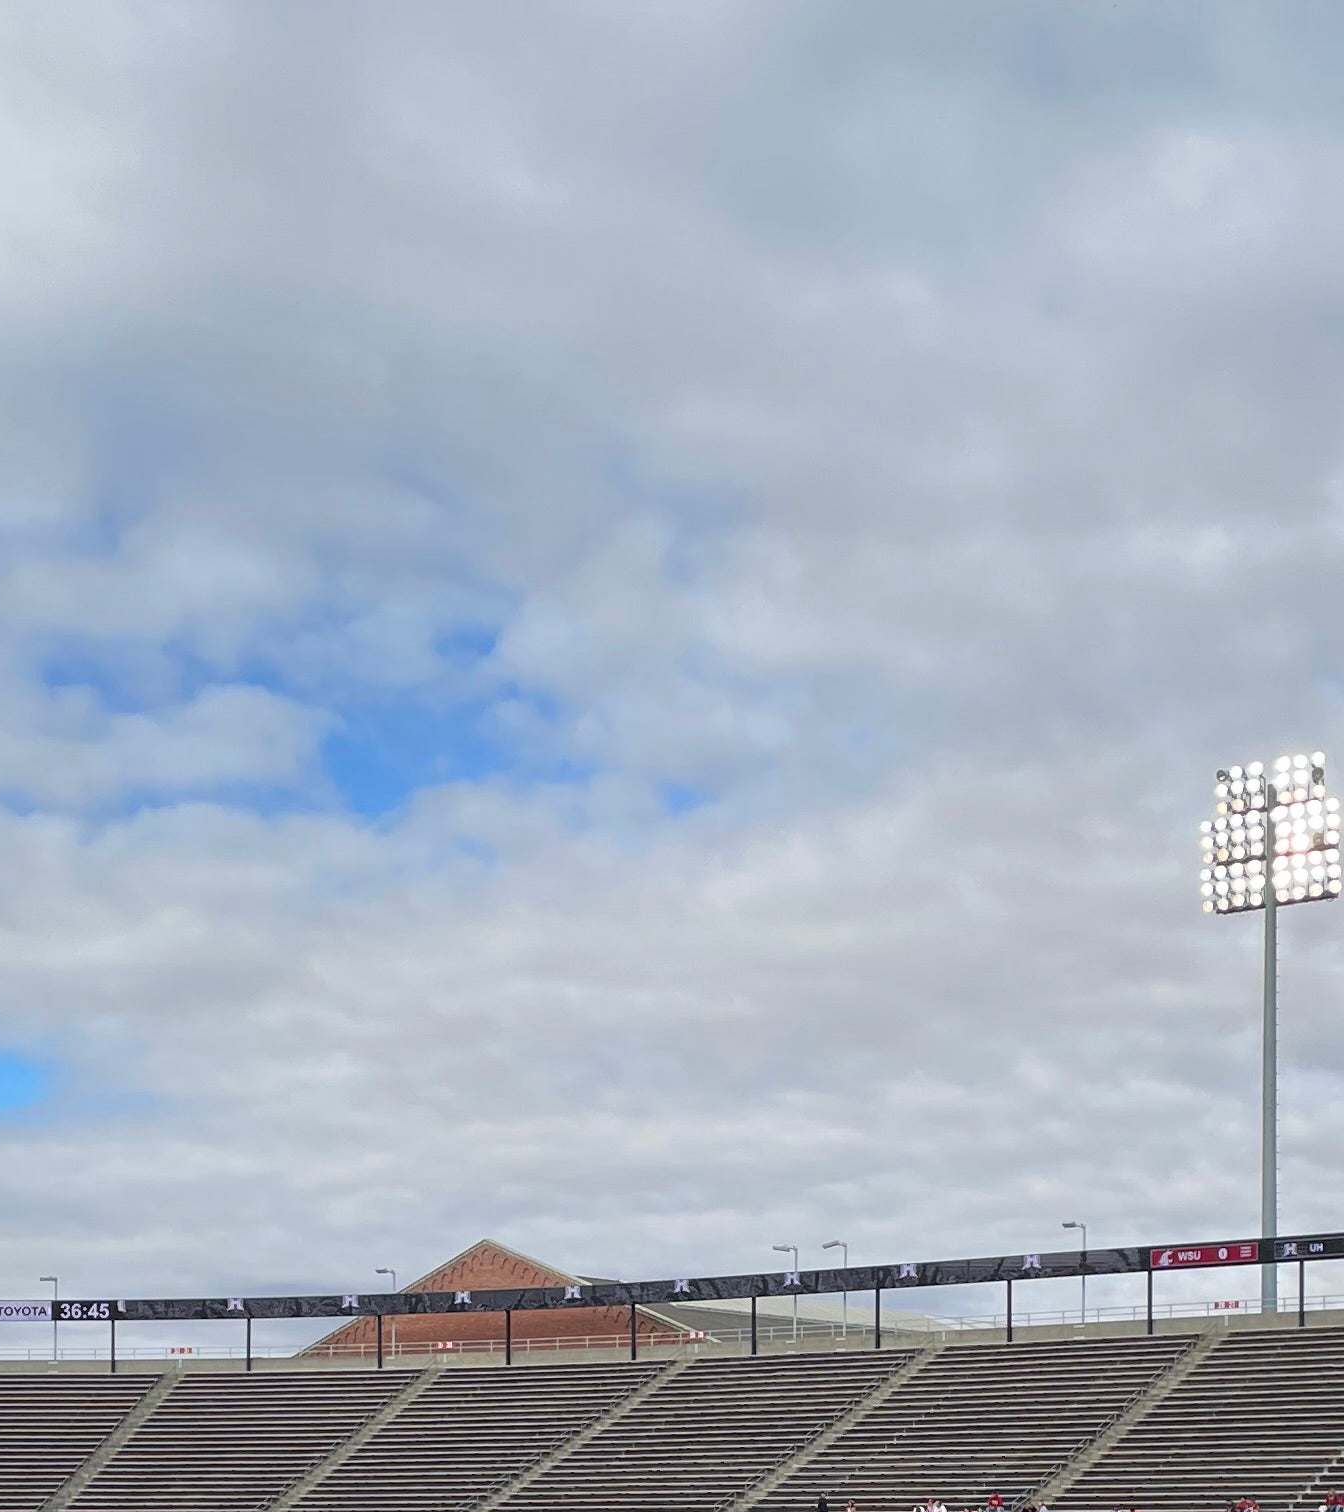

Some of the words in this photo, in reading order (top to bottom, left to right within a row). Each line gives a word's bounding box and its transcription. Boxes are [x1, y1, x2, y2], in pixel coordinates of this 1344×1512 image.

[1177, 1251, 1201, 1262] WSU
[1218, 1247, 1228, 1260] 0
[60, 1303, 110, 1320] 36:45
